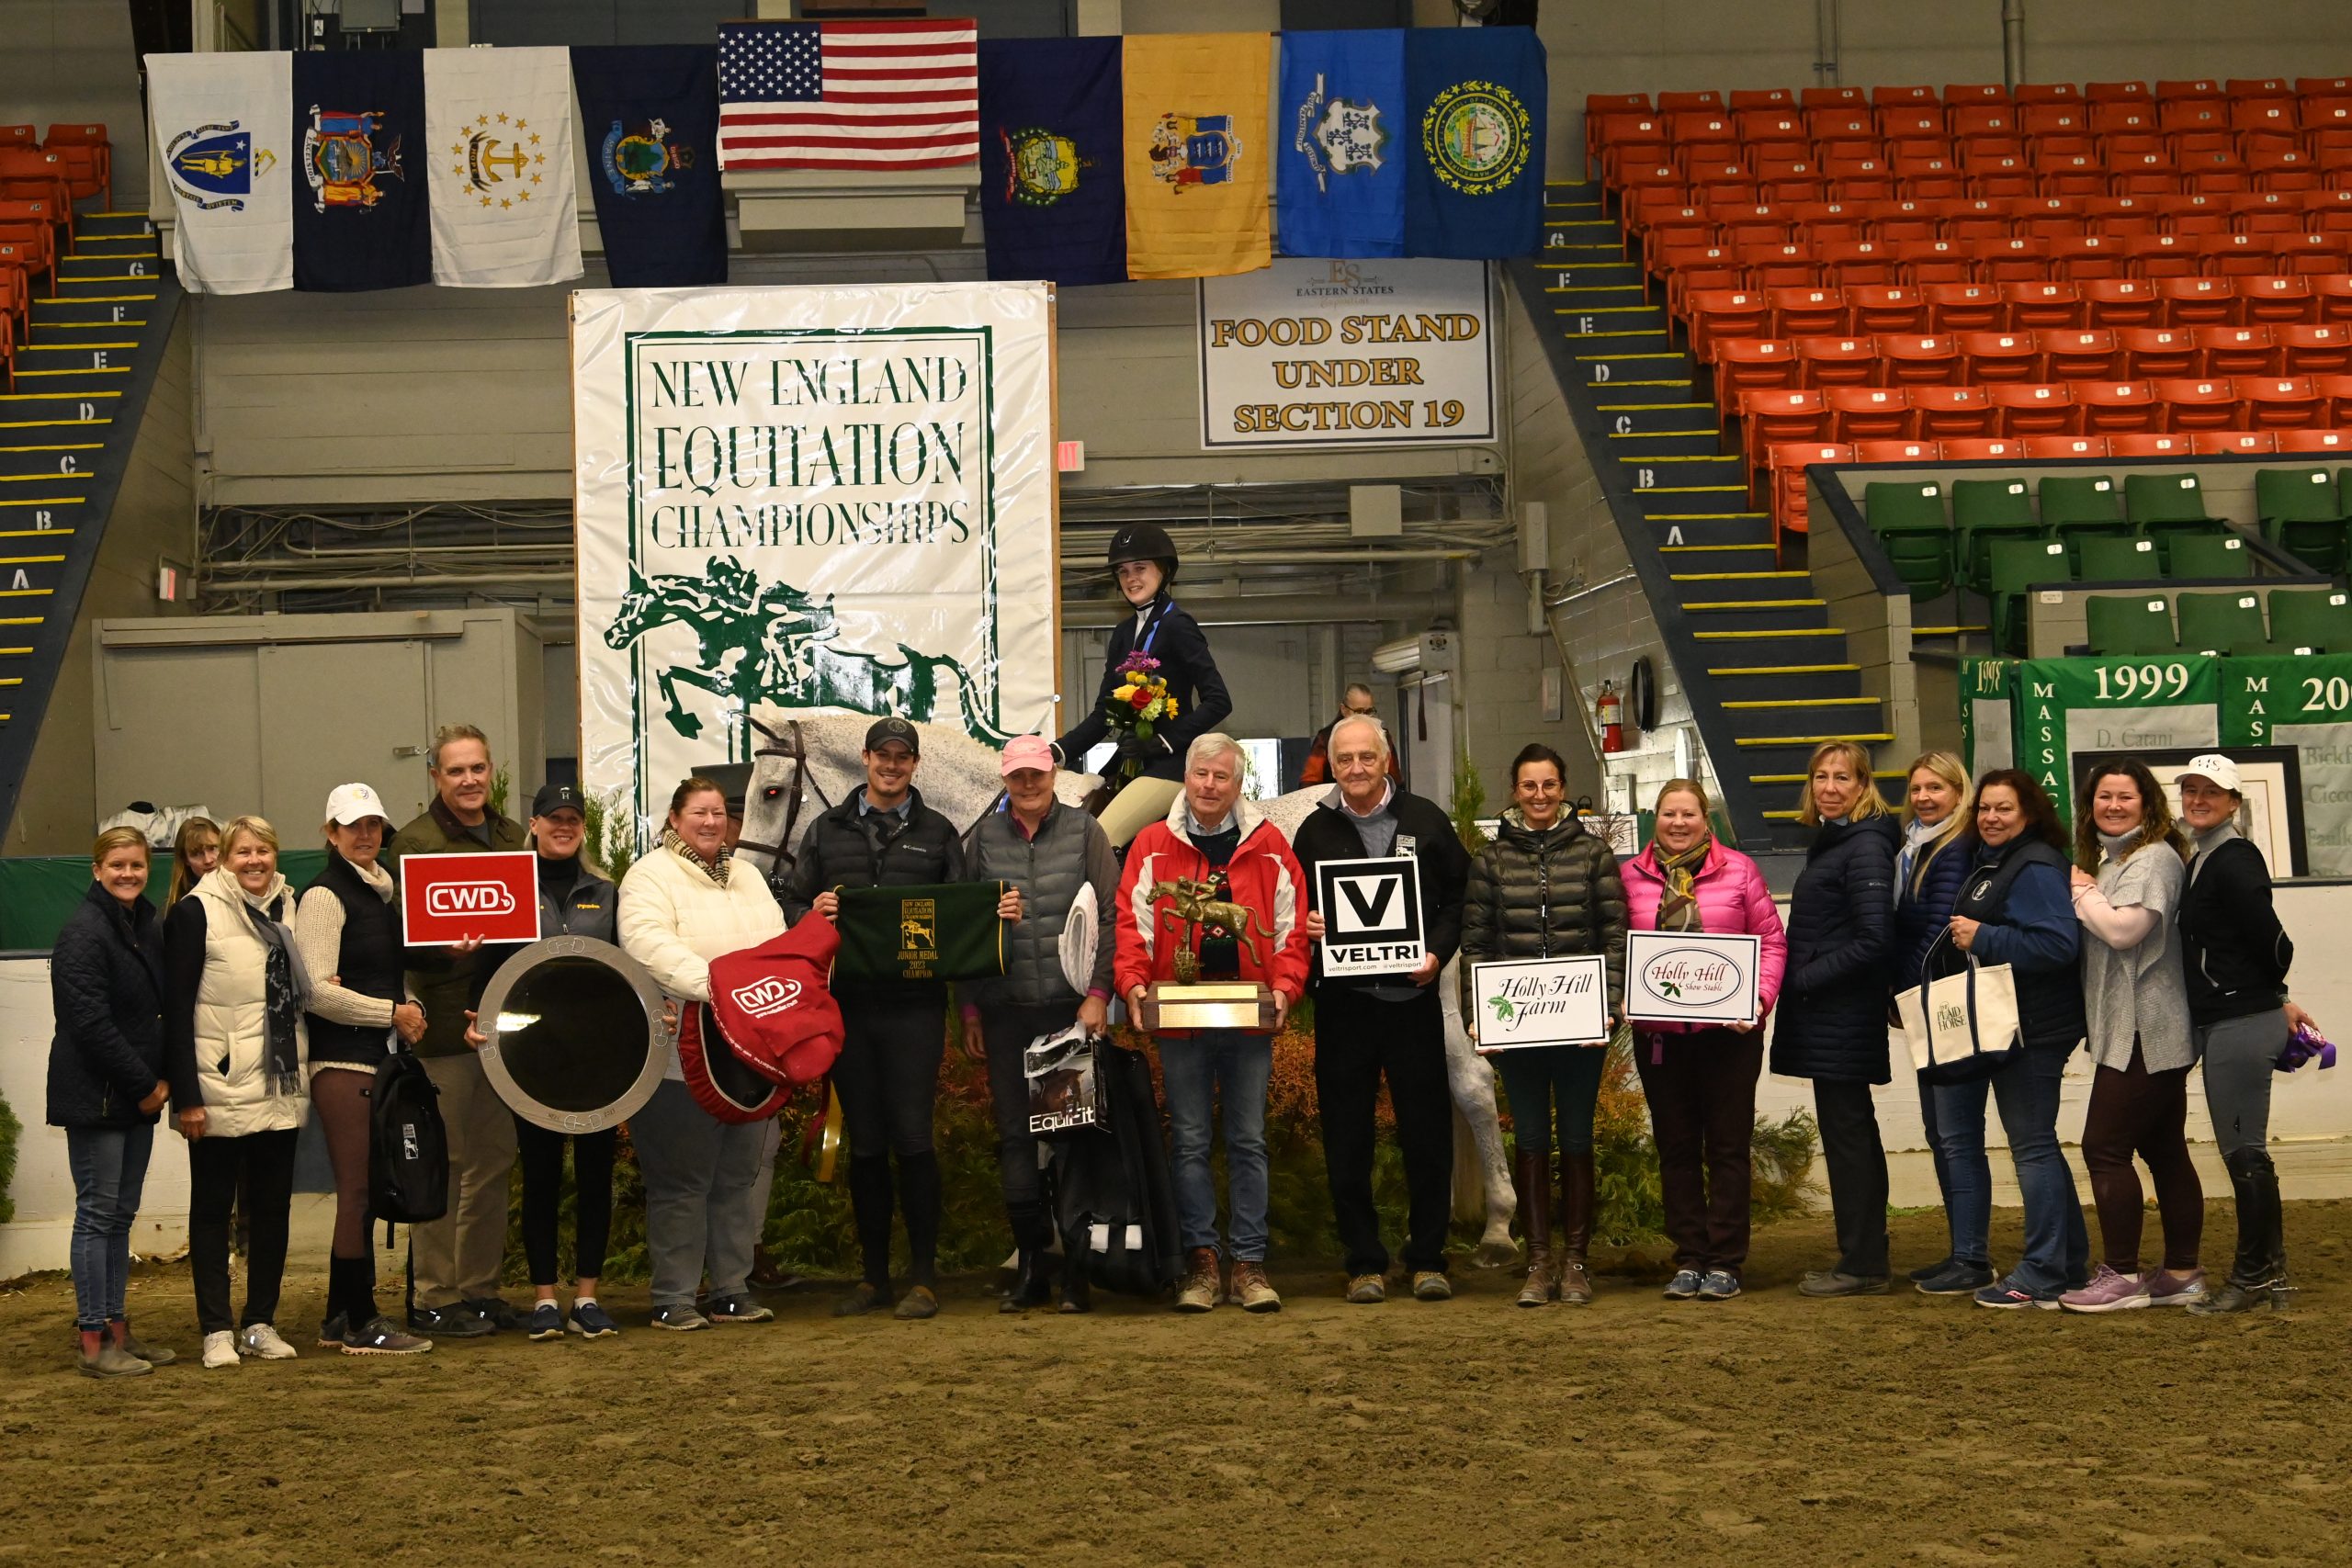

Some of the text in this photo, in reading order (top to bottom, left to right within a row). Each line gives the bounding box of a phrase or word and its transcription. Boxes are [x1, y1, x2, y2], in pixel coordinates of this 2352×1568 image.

[605, 139, 616, 175] MAINE
[1550, 232, 1565, 247] G
[129, 262, 144, 276] G
[1559, 273, 1570, 288] F
[1296, 286, 1395, 297] EASTERN STATES
[113, 306, 125, 322] F
[1211, 313, 1480, 347] FOOD STAND
[1580, 317, 1593, 334] E
[94, 351, 107, 369] E
[650, 356, 967, 408] NEW ENGLAND
[1272, 357, 1424, 389] UNDER
[1595, 364, 1610, 382] D
[80, 402, 95, 421] D
[1234, 400, 1464, 433] SECTION 19
[1616, 415, 1631, 434] C
[60, 455, 76, 474] C
[655, 421, 966, 498] EQUITATION
[1639, 468, 1655, 488] B
[36, 511, 52, 530] B
[651, 500, 969, 549] CHAMPIONSHIPS
[1667, 525, 1684, 546] A
[12, 569, 30, 590] A
[2095, 663, 2189, 701] 1999
[2301, 676, 2352, 711] 20
[2096, 728, 2173, 748] D. Catani
[432, 887, 499, 910] CWD
[1338, 878, 1398, 927] V
[898, 951, 938, 960] JUNIOR MEDAL
[1330, 945, 1419, 963] VELTRI
[902, 970, 933, 978] CHAMPION
[910, 961, 925, 969] 2023
[1329, 964, 1377, 972] veltrisport.com
[1651, 962, 1729, 987] Holly Hill
[740, 980, 786, 1008] CWD
[1499, 974, 1593, 999] Holly Hill
[1684, 982, 1723, 992] Show Stable
[1507, 998, 1566, 1032] Farm
[1937, 1006, 1962, 1020] PLAID
[1938, 1015, 1967, 1032] HORSE
[1029, 1105, 1095, 1133] EquiFit
